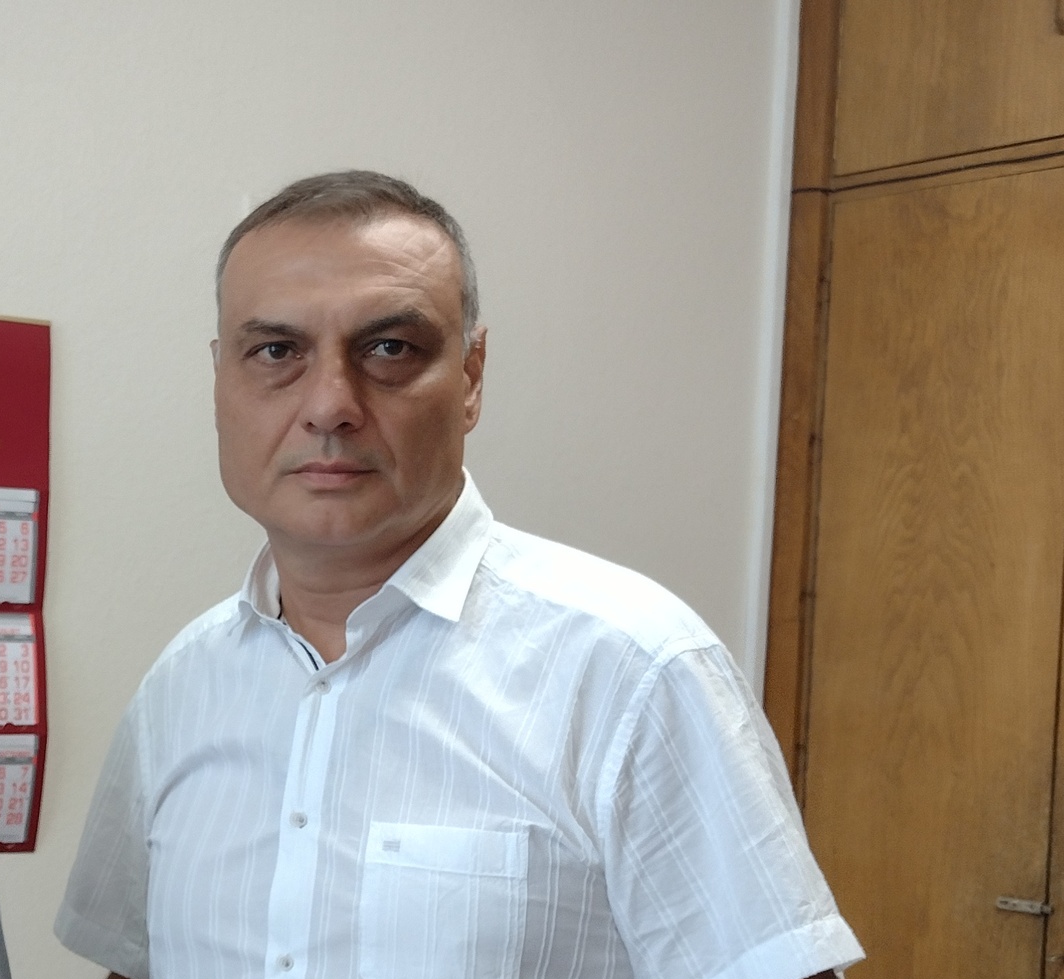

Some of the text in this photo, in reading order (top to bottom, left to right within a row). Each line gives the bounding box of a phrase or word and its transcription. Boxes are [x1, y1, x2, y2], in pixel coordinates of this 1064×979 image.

[13, 538, 29, 551] 13
[11, 555, 28, 568] 20
[10, 571, 27, 584] 27
[14, 660, 30, 673] 10
[15, 676, 29, 689] 17
[21, 766, 29, 779] 7
[12, 783, 28, 793] 14
